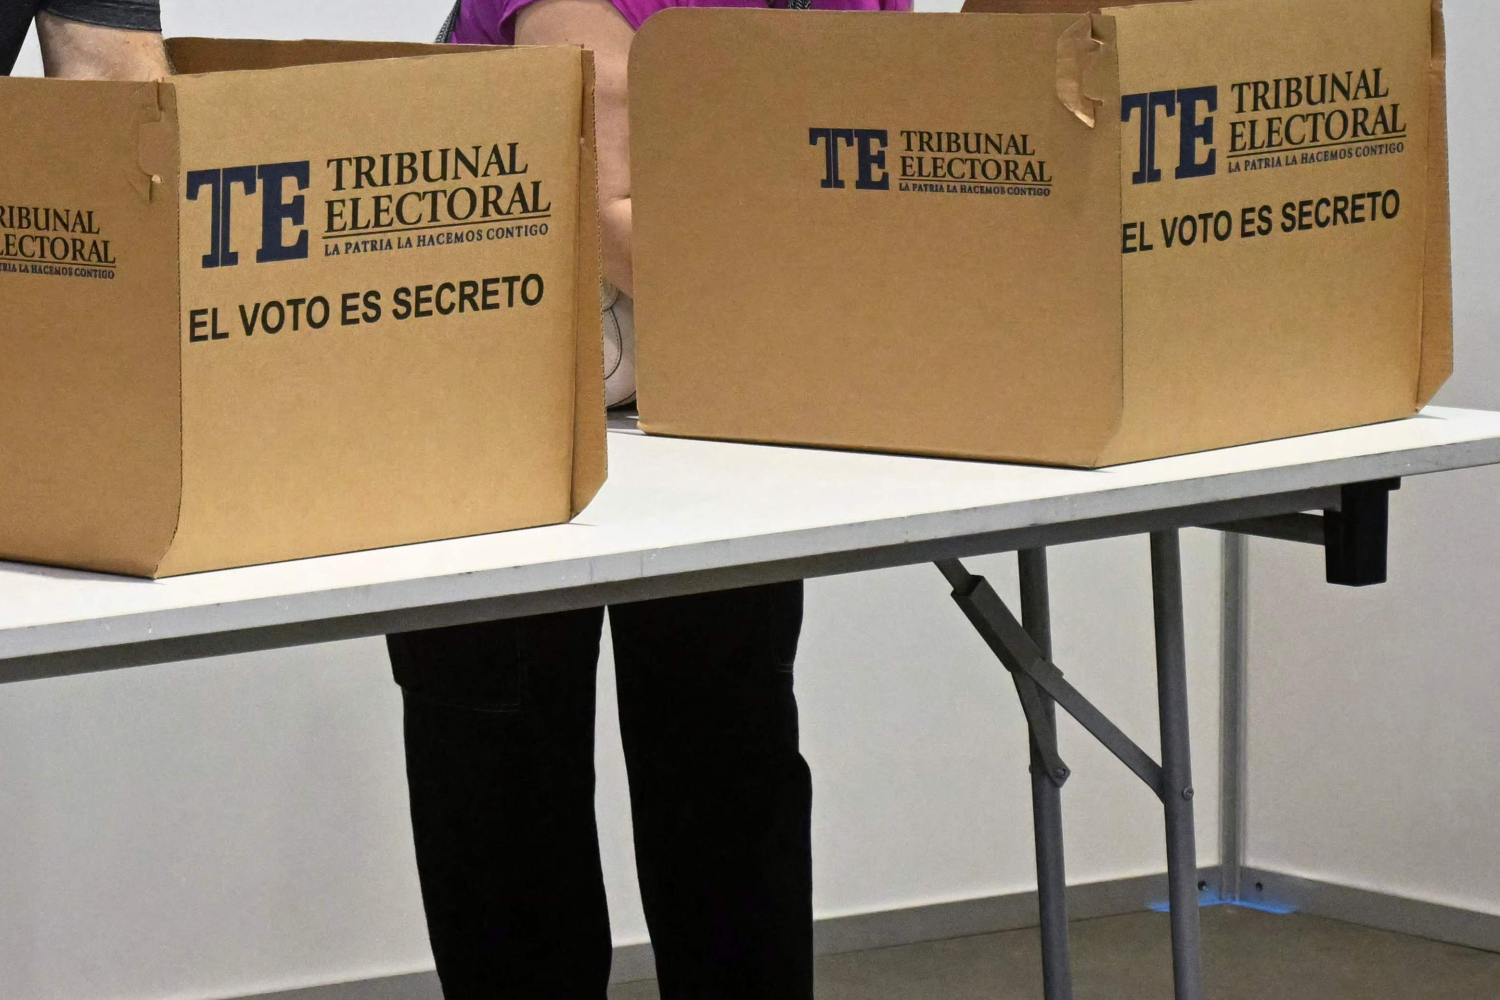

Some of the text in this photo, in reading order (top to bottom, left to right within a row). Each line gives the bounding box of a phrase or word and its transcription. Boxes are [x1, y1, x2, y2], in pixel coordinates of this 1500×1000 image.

[1231, 68, 1389, 113] TRIBUNAL
[900, 131, 1035, 156] TRIBUNAL
[1121, 86, 1218, 185] TE
[1229, 103, 1407, 153] ELECTORAL
[327, 142, 528, 191] TRIBUNAL
[809, 128, 890, 190] TE
[900, 156, 1052, 183] ELECTORAL
[1228, 142, 1404, 173] LA PATRIA LA HACEMOS CONTIGO
[324, 181, 551, 233] ELECTORAL
[899, 183, 1050, 196] LA PATRIA LA HACEMOS CONTIGO
[186, 161, 310, 269] TE
[1122, 189, 1400, 254] EL VOTO ES SECRETO
[325, 223, 548, 257] LA PATRIA LA HACEMOS CONTIGO
[19, 264, 29, 273] LA
[31, 265, 72, 276] HACEMOS
[74, 268, 114, 279] CONTIGO
[189, 273, 544, 342] EL VOTO ES SECRETO
